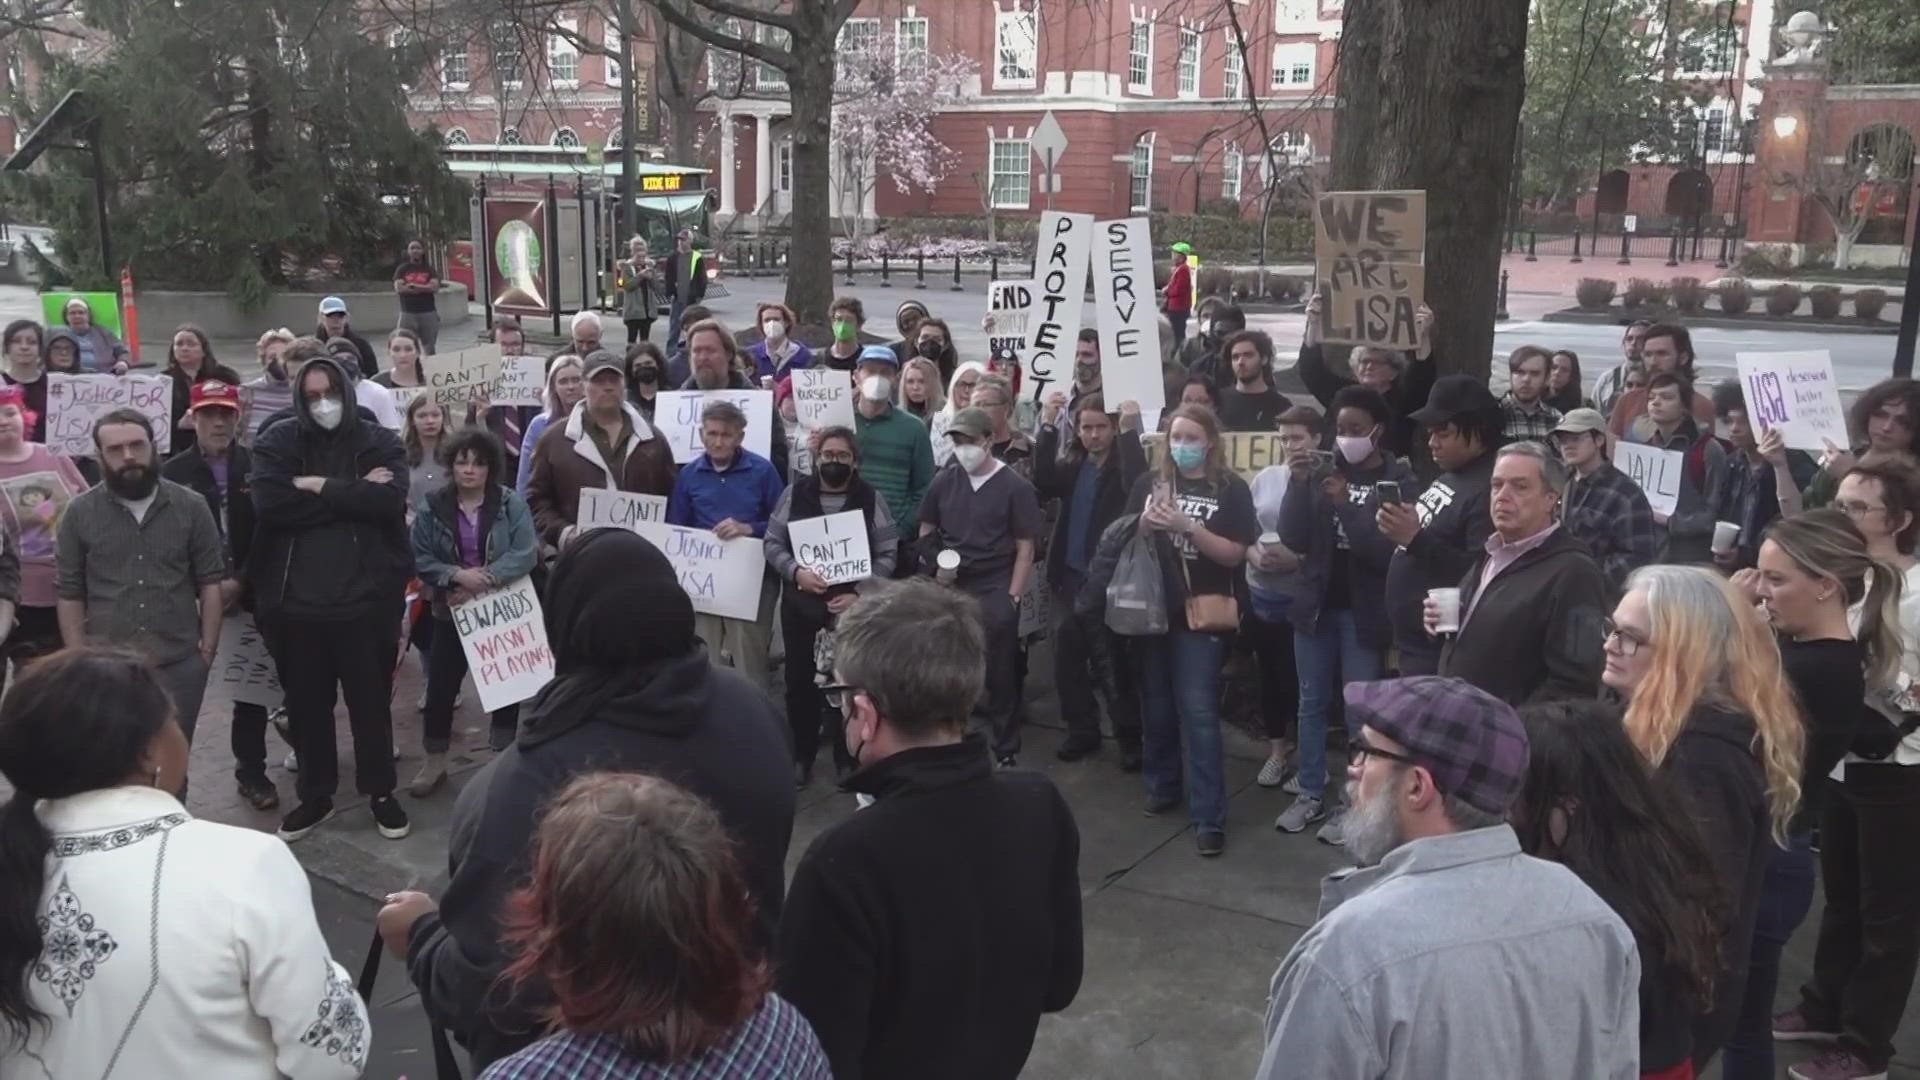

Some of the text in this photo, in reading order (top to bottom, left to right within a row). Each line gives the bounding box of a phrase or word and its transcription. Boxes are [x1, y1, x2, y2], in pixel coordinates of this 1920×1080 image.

[1319, 197, 1409, 247] WE
[1331, 248, 1409, 292] ARE
[992, 285, 1032, 310] END
[1029, 216, 1073, 403] PROTECT
[1107, 223, 1141, 358] SERVE
[1319, 280, 1418, 346] LISA
[432, 363, 489, 387] CAN'T
[802, 370, 827, 388] SIT
[591, 496, 597, 523] I
[823, 517, 829, 535] I
[799, 537, 853, 566] CAN'T
[674, 565, 715, 599] ISA
[453, 588, 534, 637] EDWARDS
[472, 621, 536, 661] WASN'T
[480, 644, 553, 686] PLAYING
